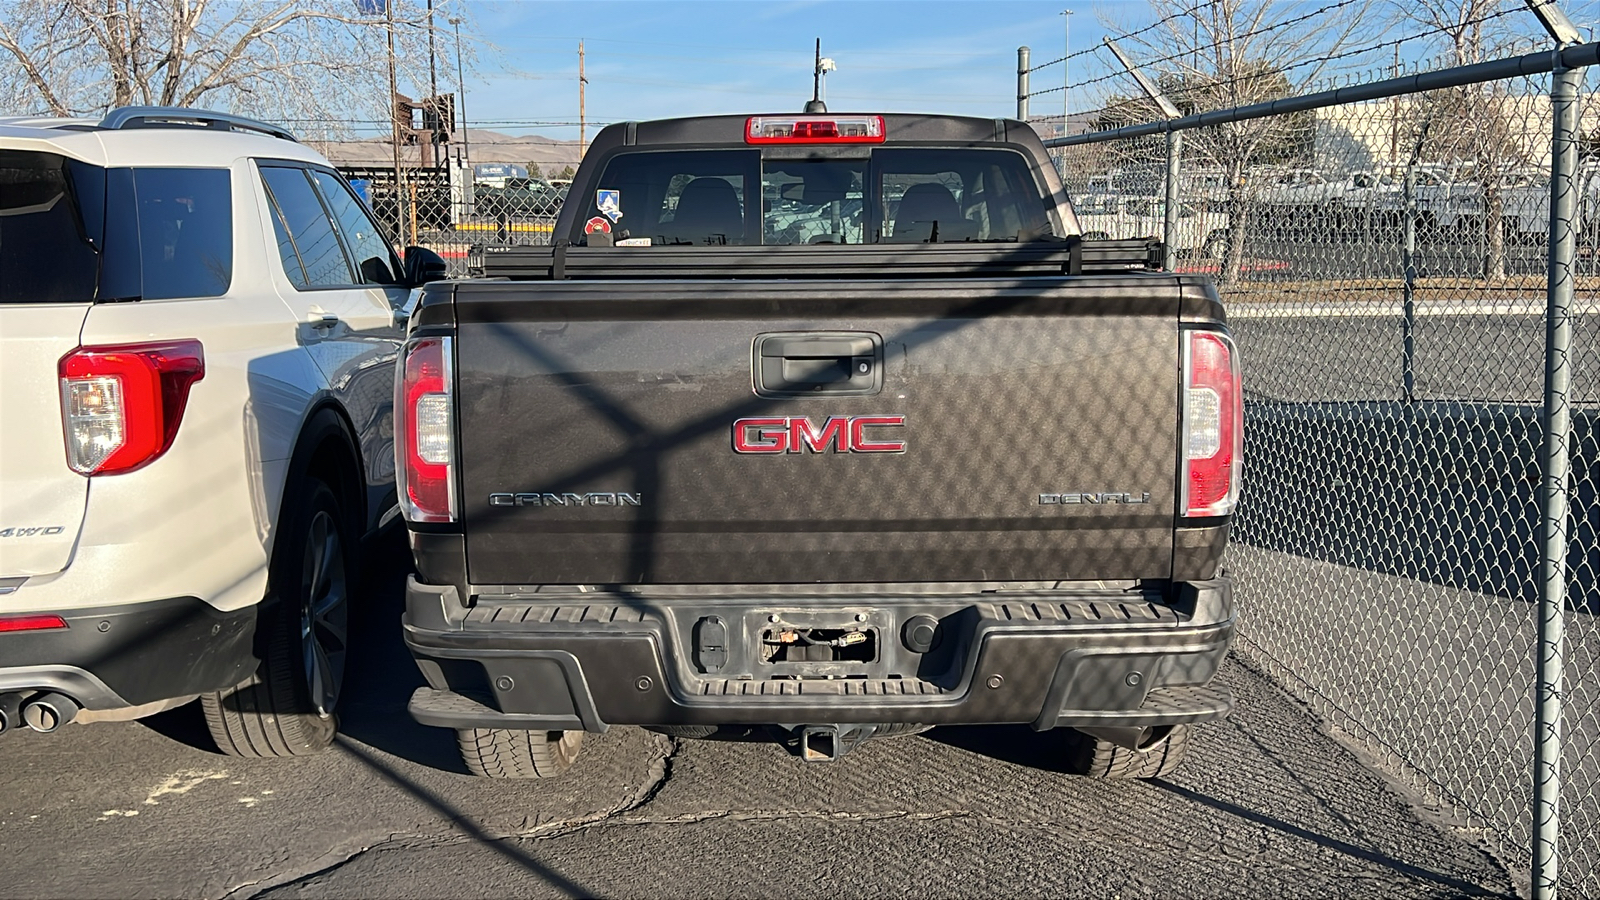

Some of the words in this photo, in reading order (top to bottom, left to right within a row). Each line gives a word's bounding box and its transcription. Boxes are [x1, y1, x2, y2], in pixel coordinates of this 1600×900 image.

[732, 416, 906, 454] GMC
[489, 492, 642, 507] CANYON
[1038, 492, 1150, 505] DENALI
[0, 526, 65, 537] 4WD
